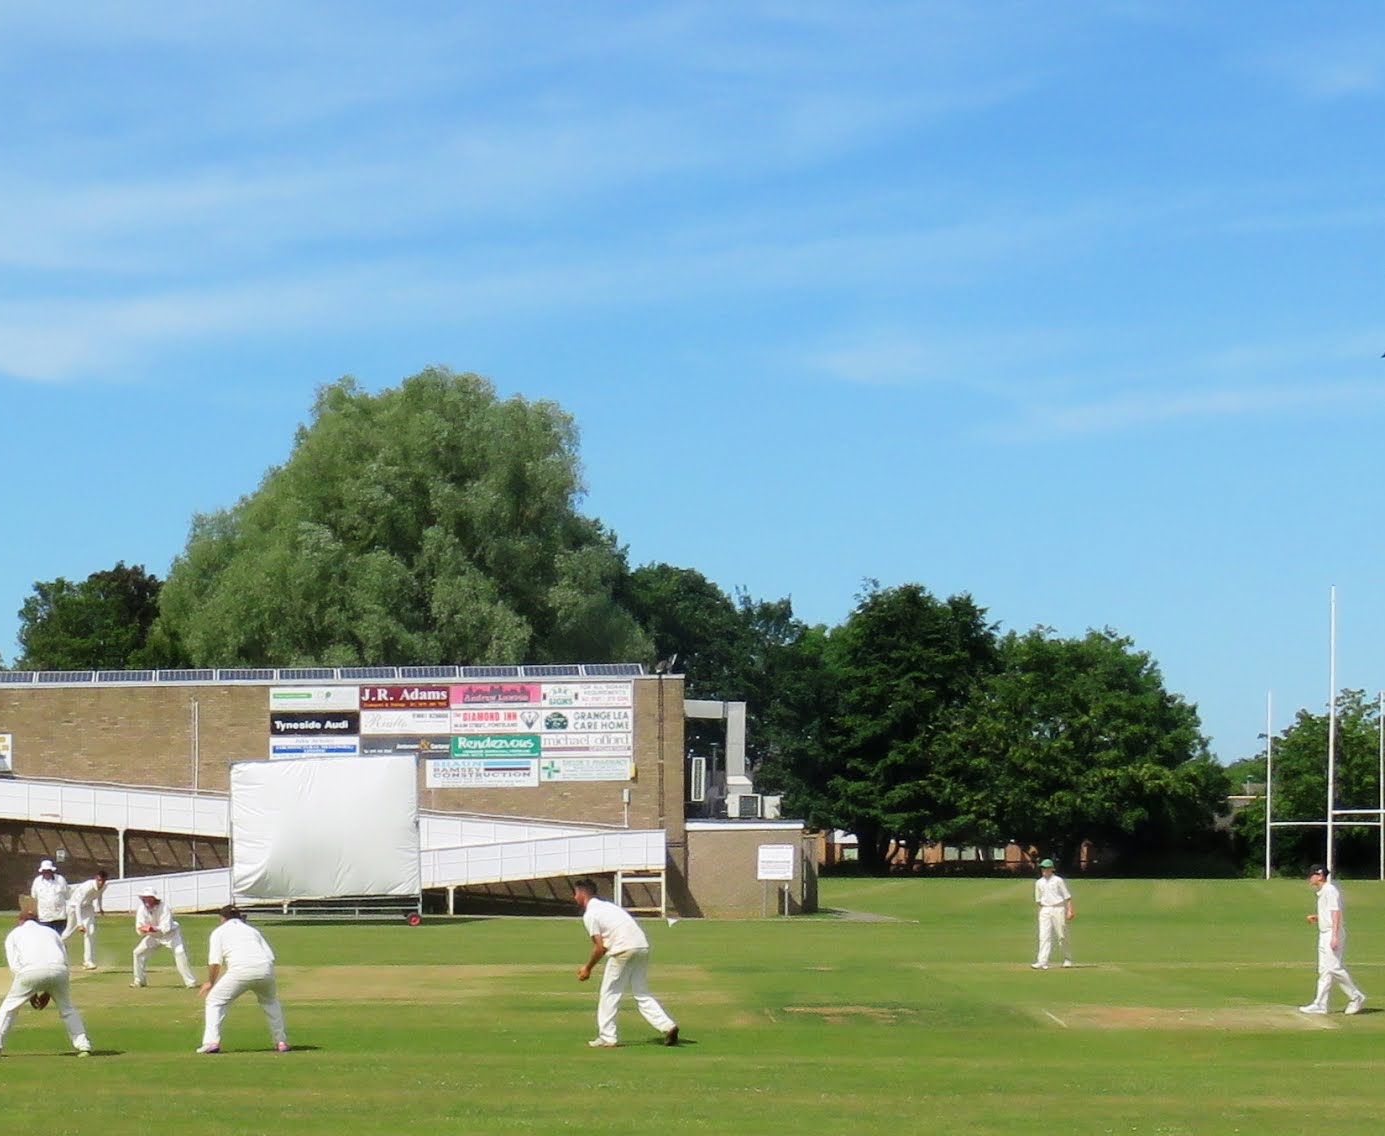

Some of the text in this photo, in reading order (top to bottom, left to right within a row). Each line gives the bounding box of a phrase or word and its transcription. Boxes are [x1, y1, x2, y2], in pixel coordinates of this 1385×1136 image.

[361, 688, 448, 701] J.R. Adams
[463, 712, 500, 721] DIAMOND
[504, 712, 517, 720] INN
[573, 712, 629, 720] GRANGE LEA
[274, 720, 349, 732] Tyneside Audi
[573, 721, 629, 730] CARE HOME
[458, 736, 535, 749] Rendezvous
